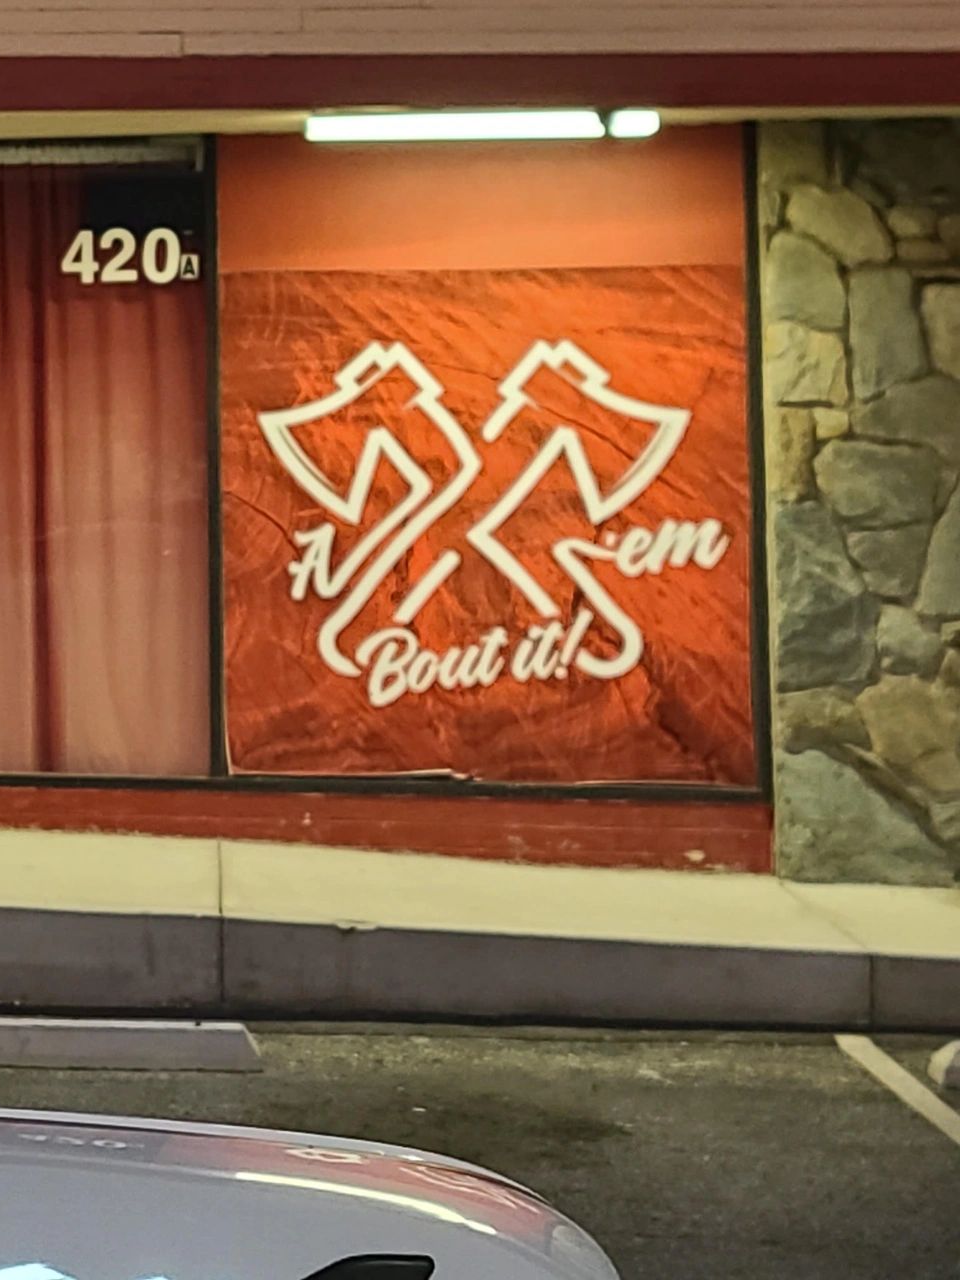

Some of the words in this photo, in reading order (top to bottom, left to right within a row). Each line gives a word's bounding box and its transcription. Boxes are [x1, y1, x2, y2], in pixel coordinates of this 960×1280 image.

[61, 227, 181, 284] 420
[355, 626, 508, 707] Bout
[511, 609, 593, 682] it!
